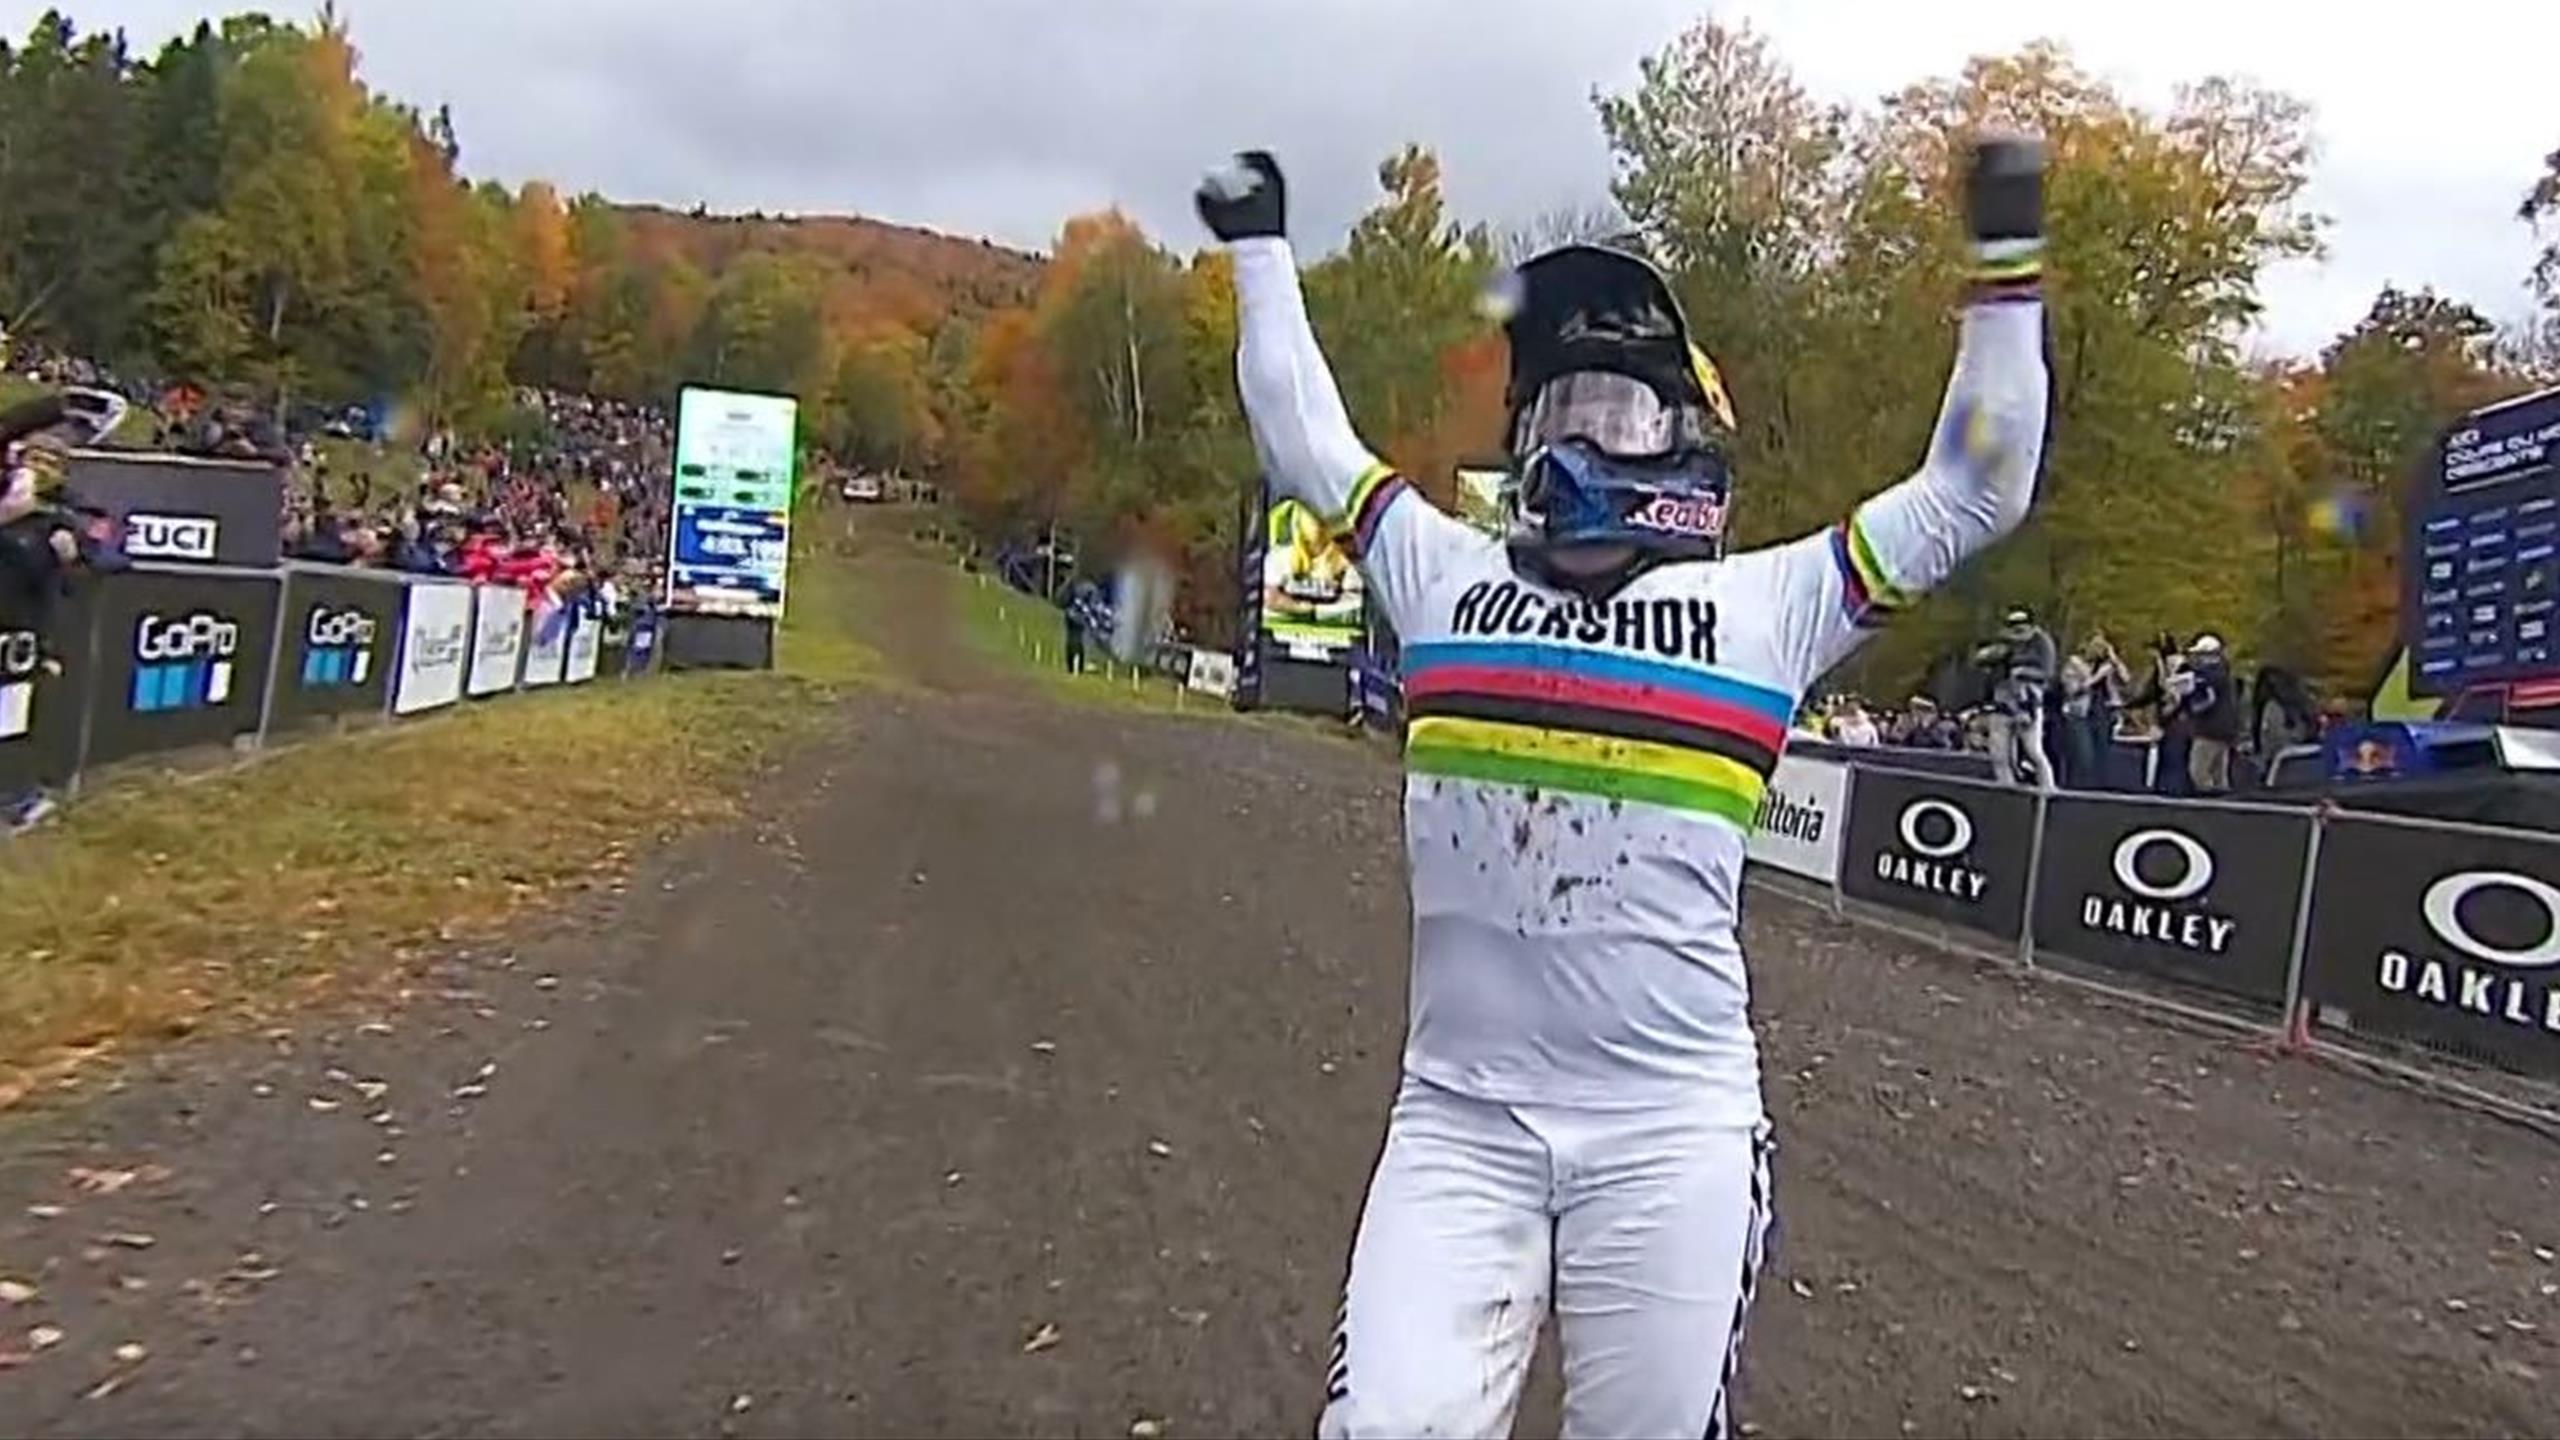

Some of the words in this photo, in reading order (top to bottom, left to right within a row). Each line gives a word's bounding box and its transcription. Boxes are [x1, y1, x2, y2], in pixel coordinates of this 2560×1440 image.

[144, 524, 208, 550] UCI
[138, 614, 238, 660] GoPro
[308, 606, 376, 645] GoPro
[1450, 579, 1718, 666] ROCKSHOX
[1877, 852, 1987, 898] OAKLEY
[2083, 895, 2237, 951] OAKLEY
[2380, 951, 2560, 1033] OAKLE
